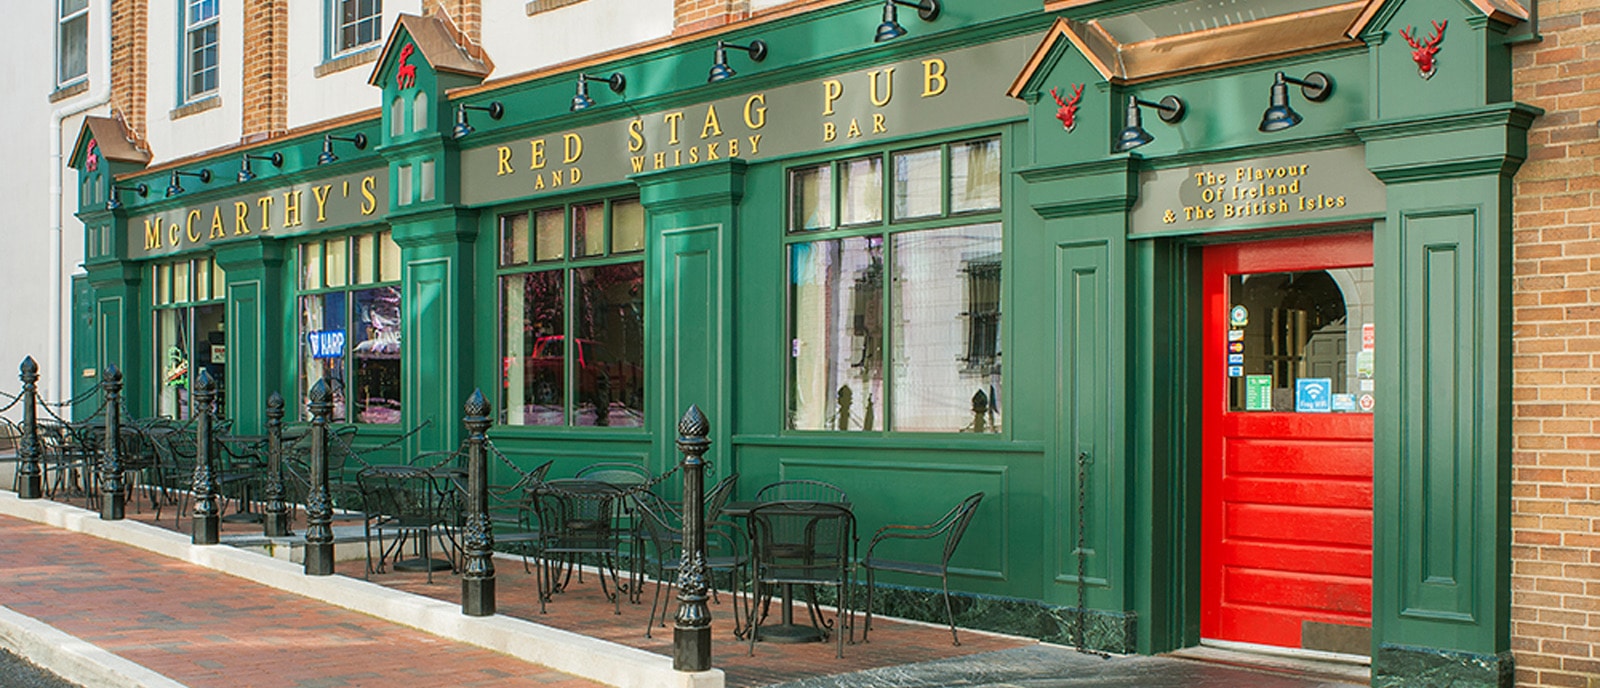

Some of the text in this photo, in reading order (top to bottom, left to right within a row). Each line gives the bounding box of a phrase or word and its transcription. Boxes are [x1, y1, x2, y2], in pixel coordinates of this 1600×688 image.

[496, 57, 950, 176] RED STAG PUB
[534, 113, 889, 191] AND WHISKEY BAR
[1194, 163, 1309, 187] The Flavour
[1201, 179, 1300, 204] Of Ireland
[143, 175, 377, 251] McCARTHY'S
[1163, 193, 1346, 224] & The British Isles
[320, 332, 345, 356] HARP
